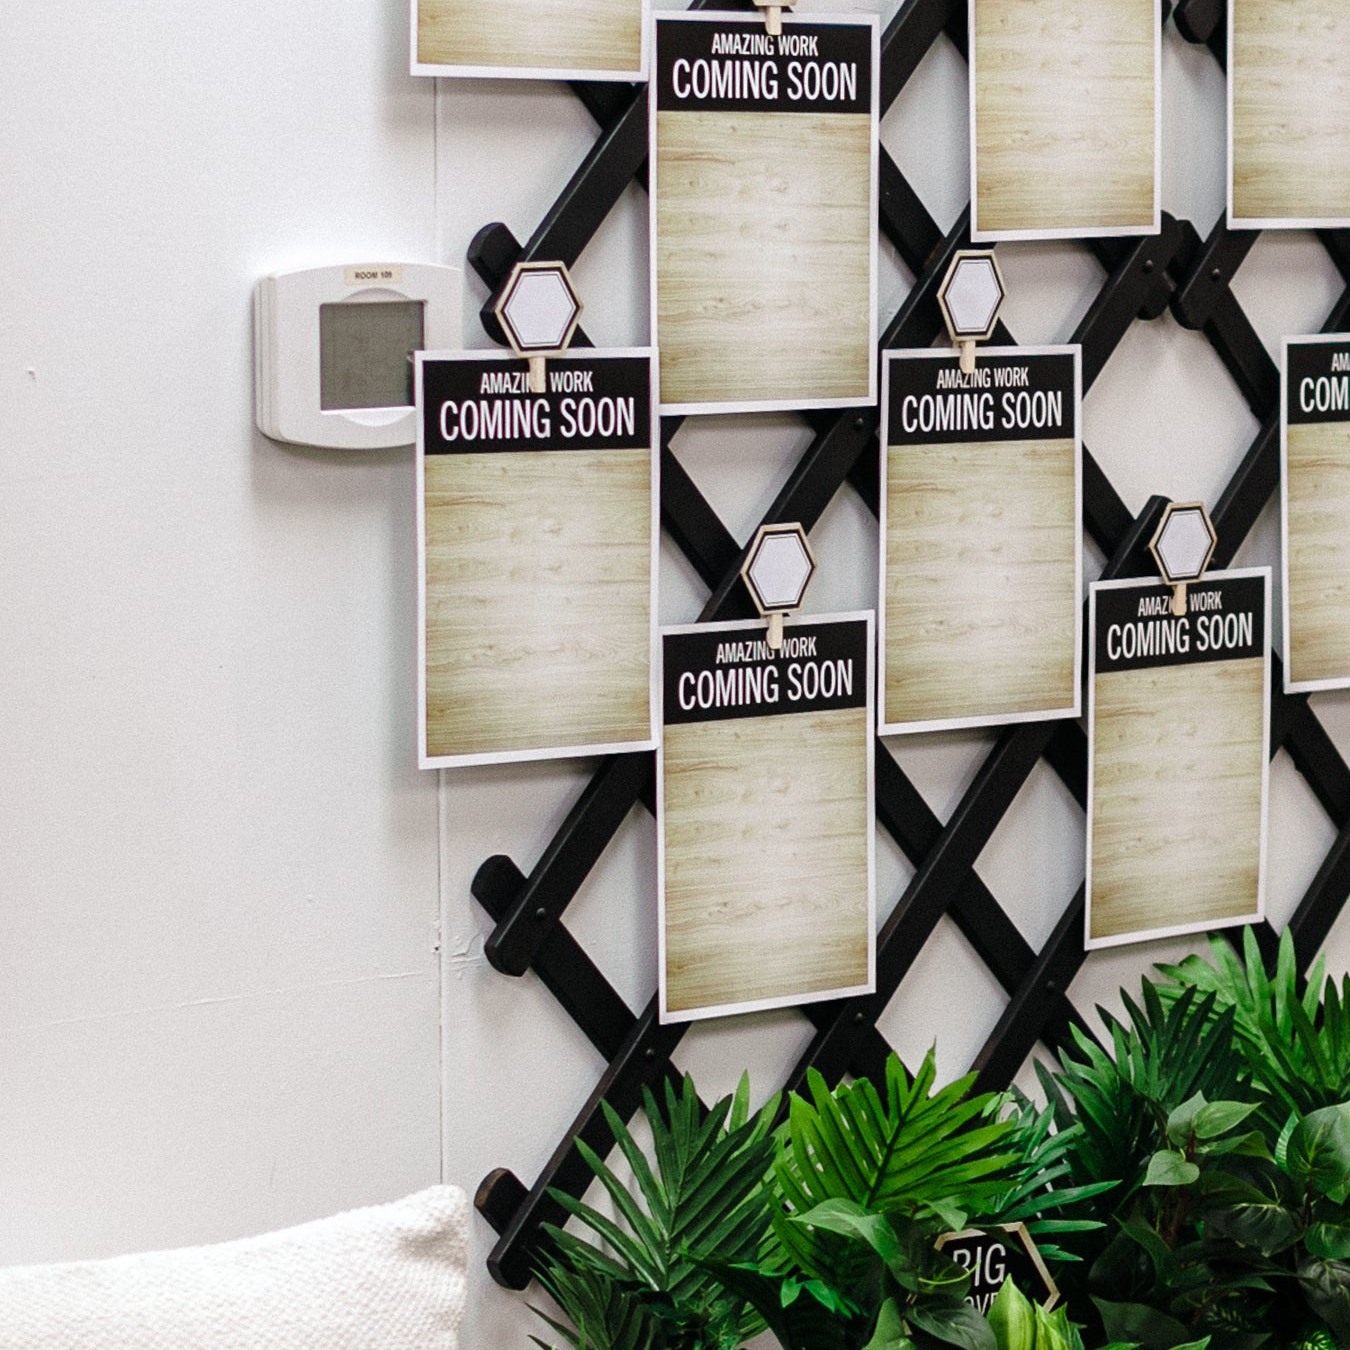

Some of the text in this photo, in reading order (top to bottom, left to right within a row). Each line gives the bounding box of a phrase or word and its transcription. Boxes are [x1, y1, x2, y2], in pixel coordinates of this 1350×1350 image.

[712, 34, 818, 57] AMAZING WORK
[672, 59, 857, 101] COMING SOON
[354, 271, 378, 280] ROOM
[550, 371, 593, 393] WORK
[936, 366, 1029, 390] AMAZING WORK
[440, 397, 635, 440] COMING SOON
[902, 390, 1062, 432] COMING SOON
[1138, 591, 1222, 617] AMAZI WORK
[1107, 612, 1253, 661] COMING SOON
[679, 658, 853, 710] COMING SOON
